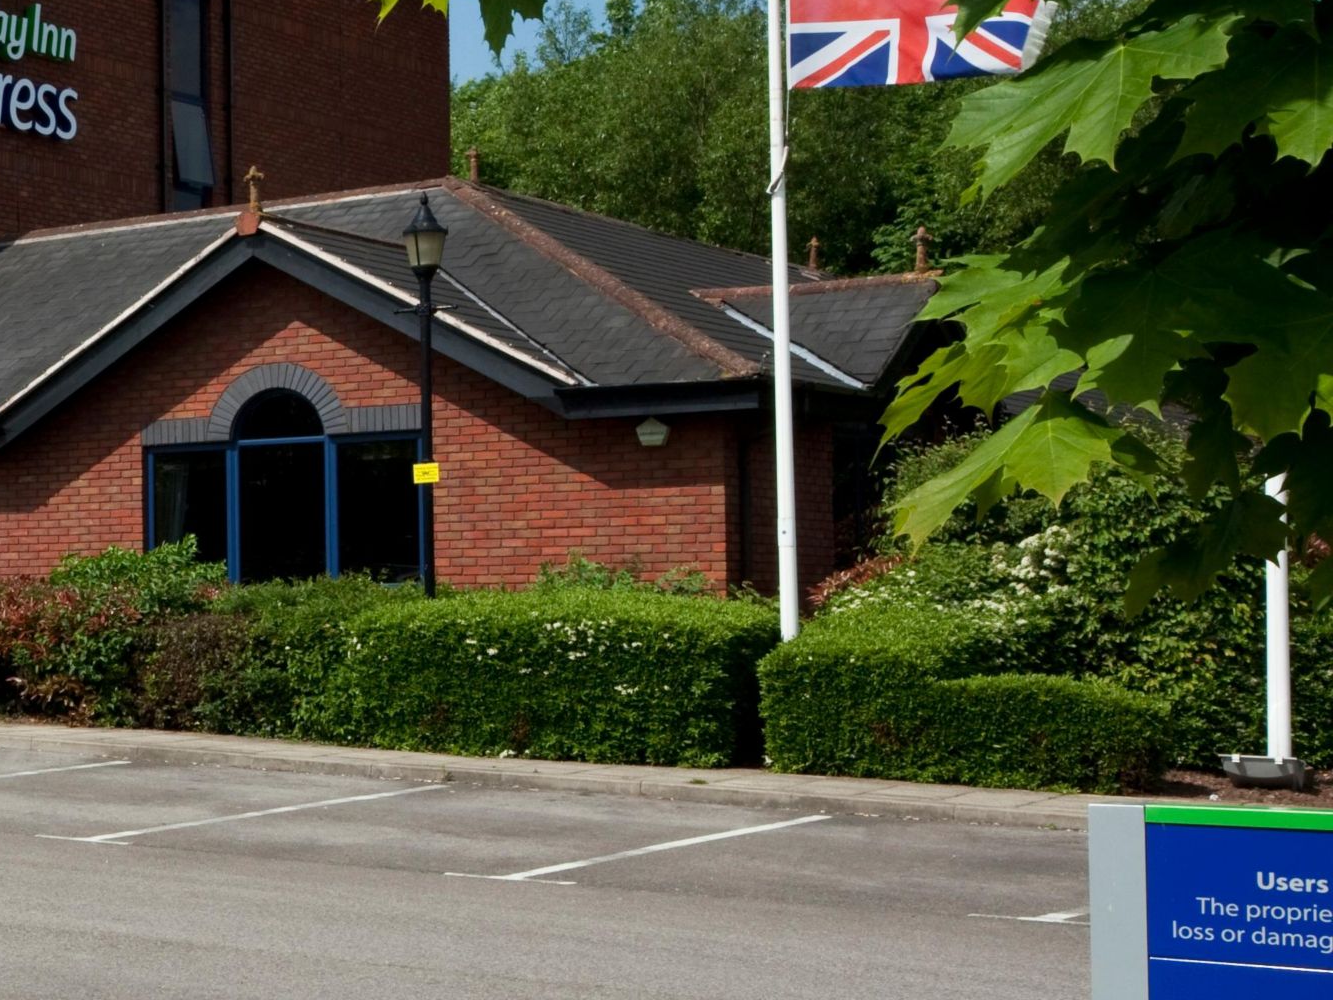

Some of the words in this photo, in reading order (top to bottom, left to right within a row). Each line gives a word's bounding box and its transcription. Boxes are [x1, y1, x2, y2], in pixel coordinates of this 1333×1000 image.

[32, 3, 77, 62] Inn
[1256, 871, 1330, 893] Users
[1195, 896, 1239, 917] The
[1246, 903, 1333, 925] proprie
[1172, 920, 1215, 941] loss
[1220, 928, 1246, 943] or
[1251, 926, 1333, 954] damag
